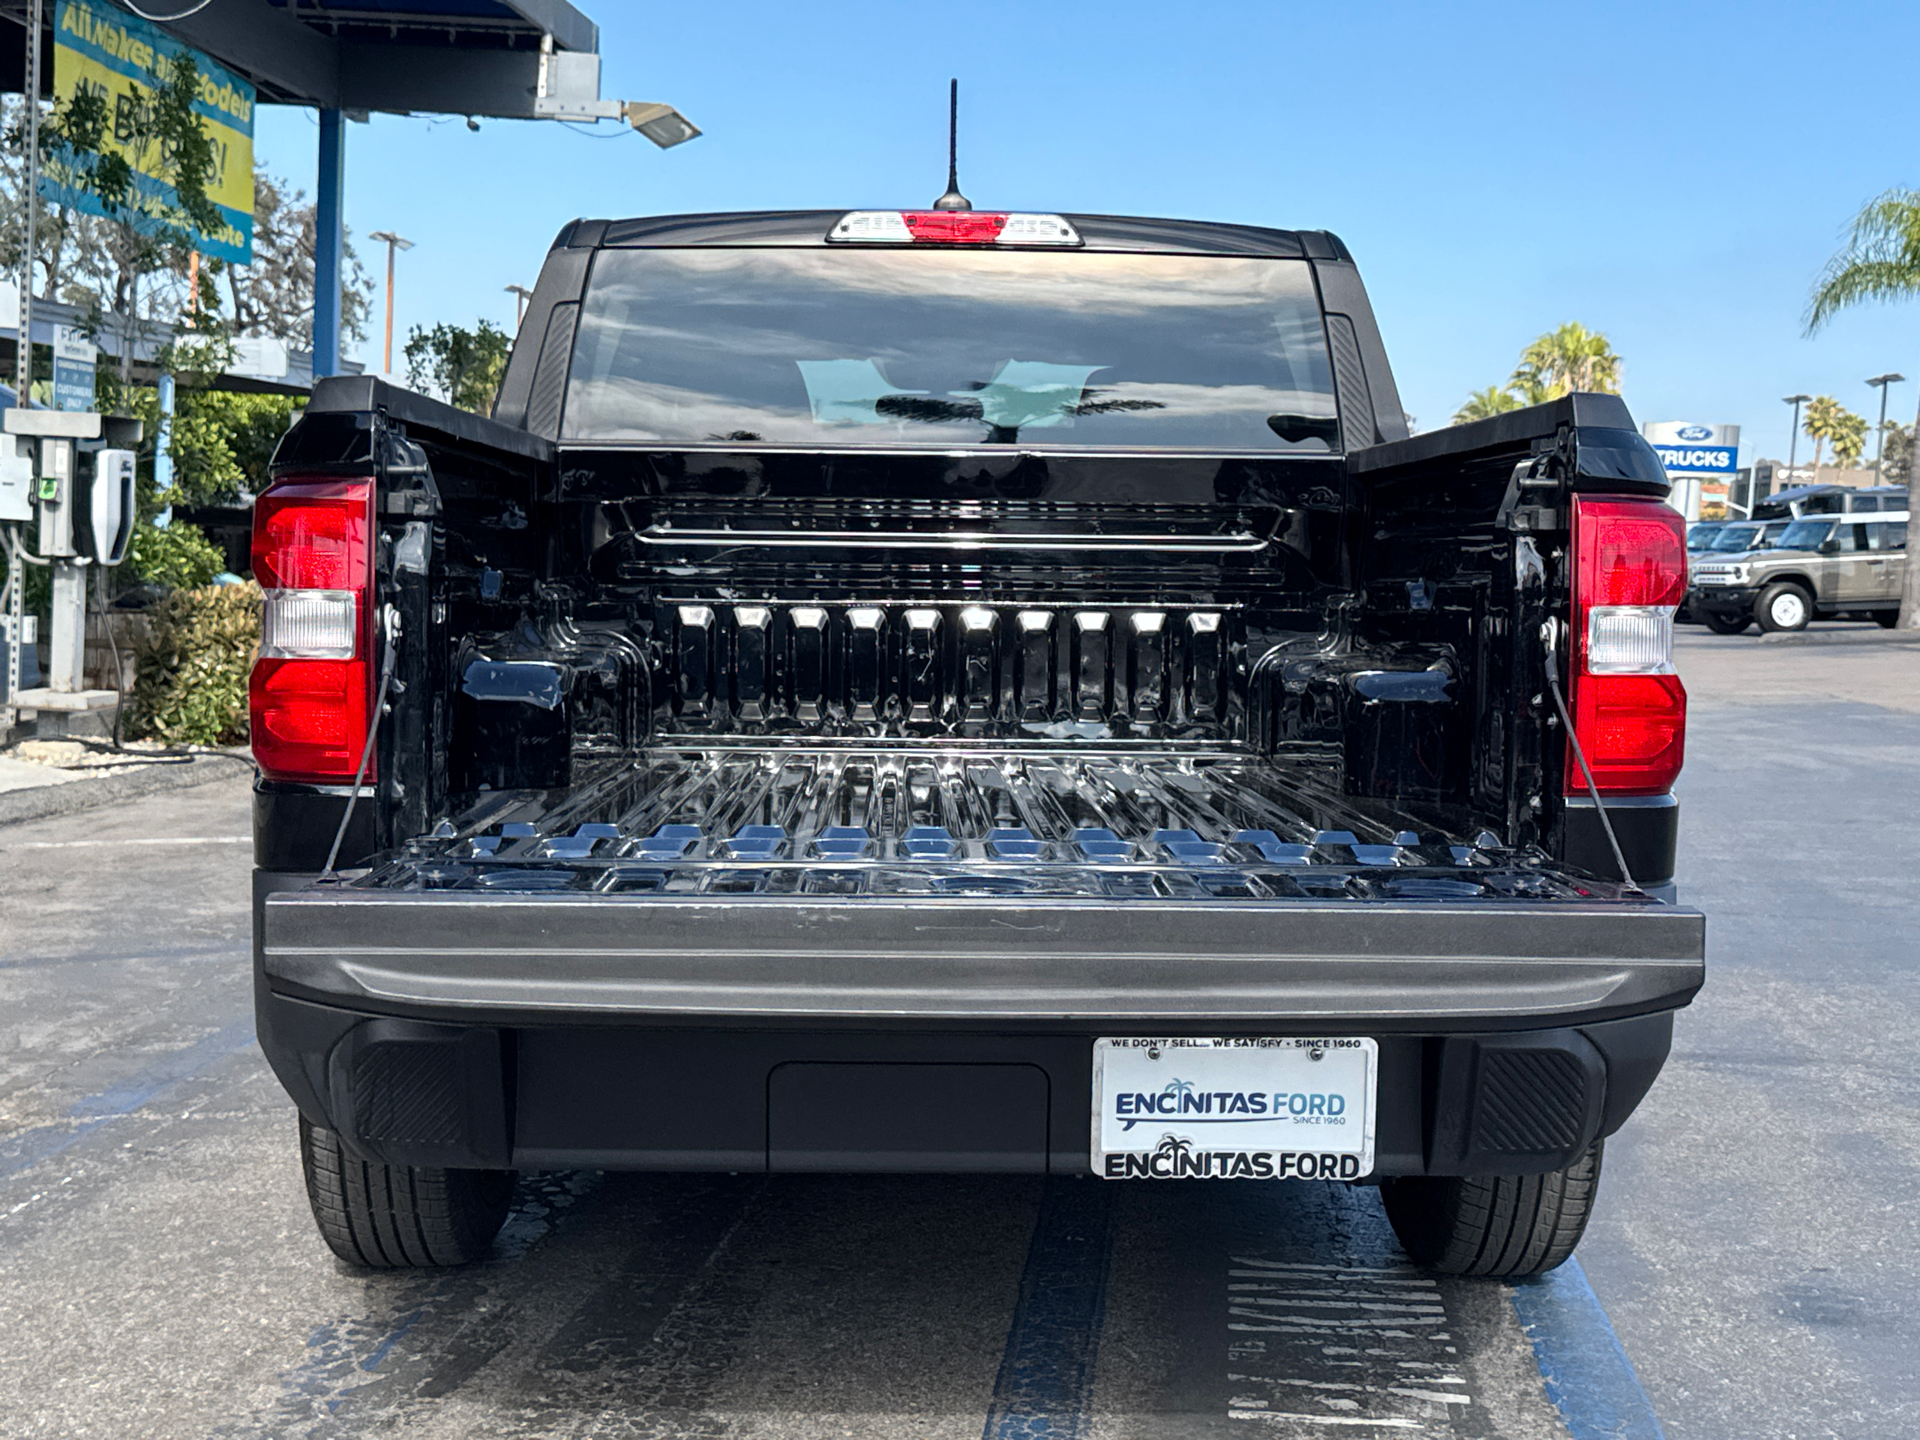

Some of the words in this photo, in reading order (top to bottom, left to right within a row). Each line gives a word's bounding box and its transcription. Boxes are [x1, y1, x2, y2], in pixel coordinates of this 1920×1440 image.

[61, 1, 92, 42] All
[91, 17, 154, 71] Makes
[1681, 427, 1708, 439] Ford
[1111, 1039, 1130, 1048] WE
[1132, 1039, 1169, 1048] DON'T
[1213, 1039, 1232, 1048] WE
[1233, 1039, 1283, 1048] SATISFY
[1294, 1039, 1331, 1048] SINCE
[1333, 1039, 1362, 1048] 1960
[1116, 1079, 1268, 1115] ENCINITAS
[1273, 1093, 1346, 1115] FORD
[1292, 1116, 1322, 1125] SINCE
[1323, 1116, 1346, 1126] 1960
[1105, 1137, 1274, 1178] ENCINITAS
[1279, 1152, 1361, 1179] FORD
